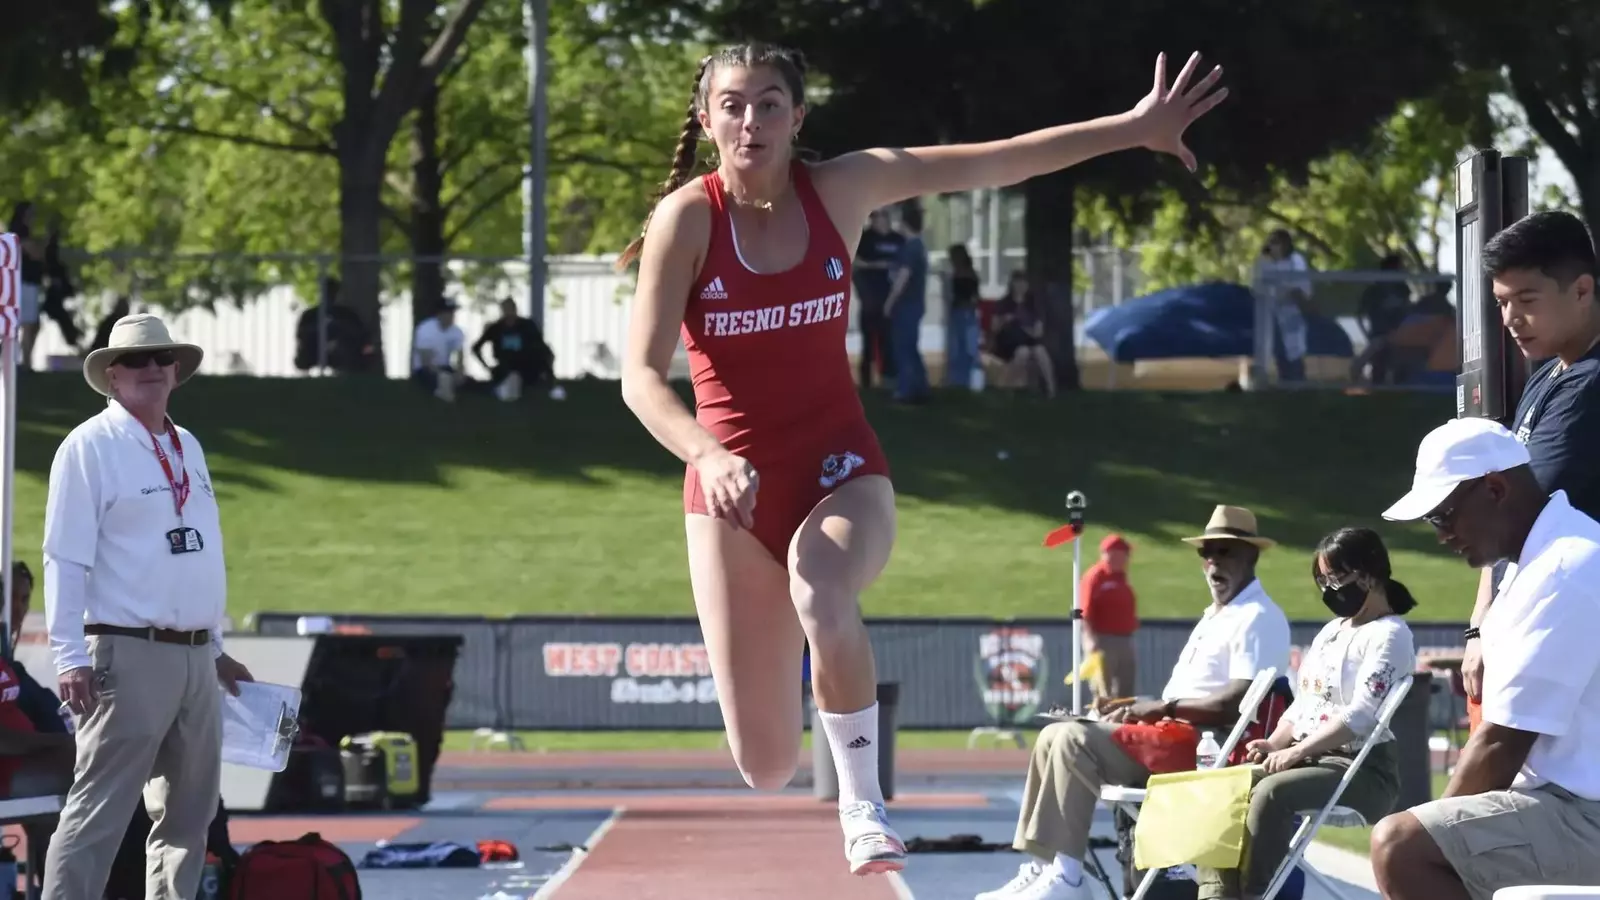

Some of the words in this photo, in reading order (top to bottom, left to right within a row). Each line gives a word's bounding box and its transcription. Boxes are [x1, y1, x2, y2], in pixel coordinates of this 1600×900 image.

[700, 291, 728, 300] adidas
[704, 305, 785, 336] FRESNO
[788, 292, 845, 327] STATE
[543, 642, 623, 677] WEST
